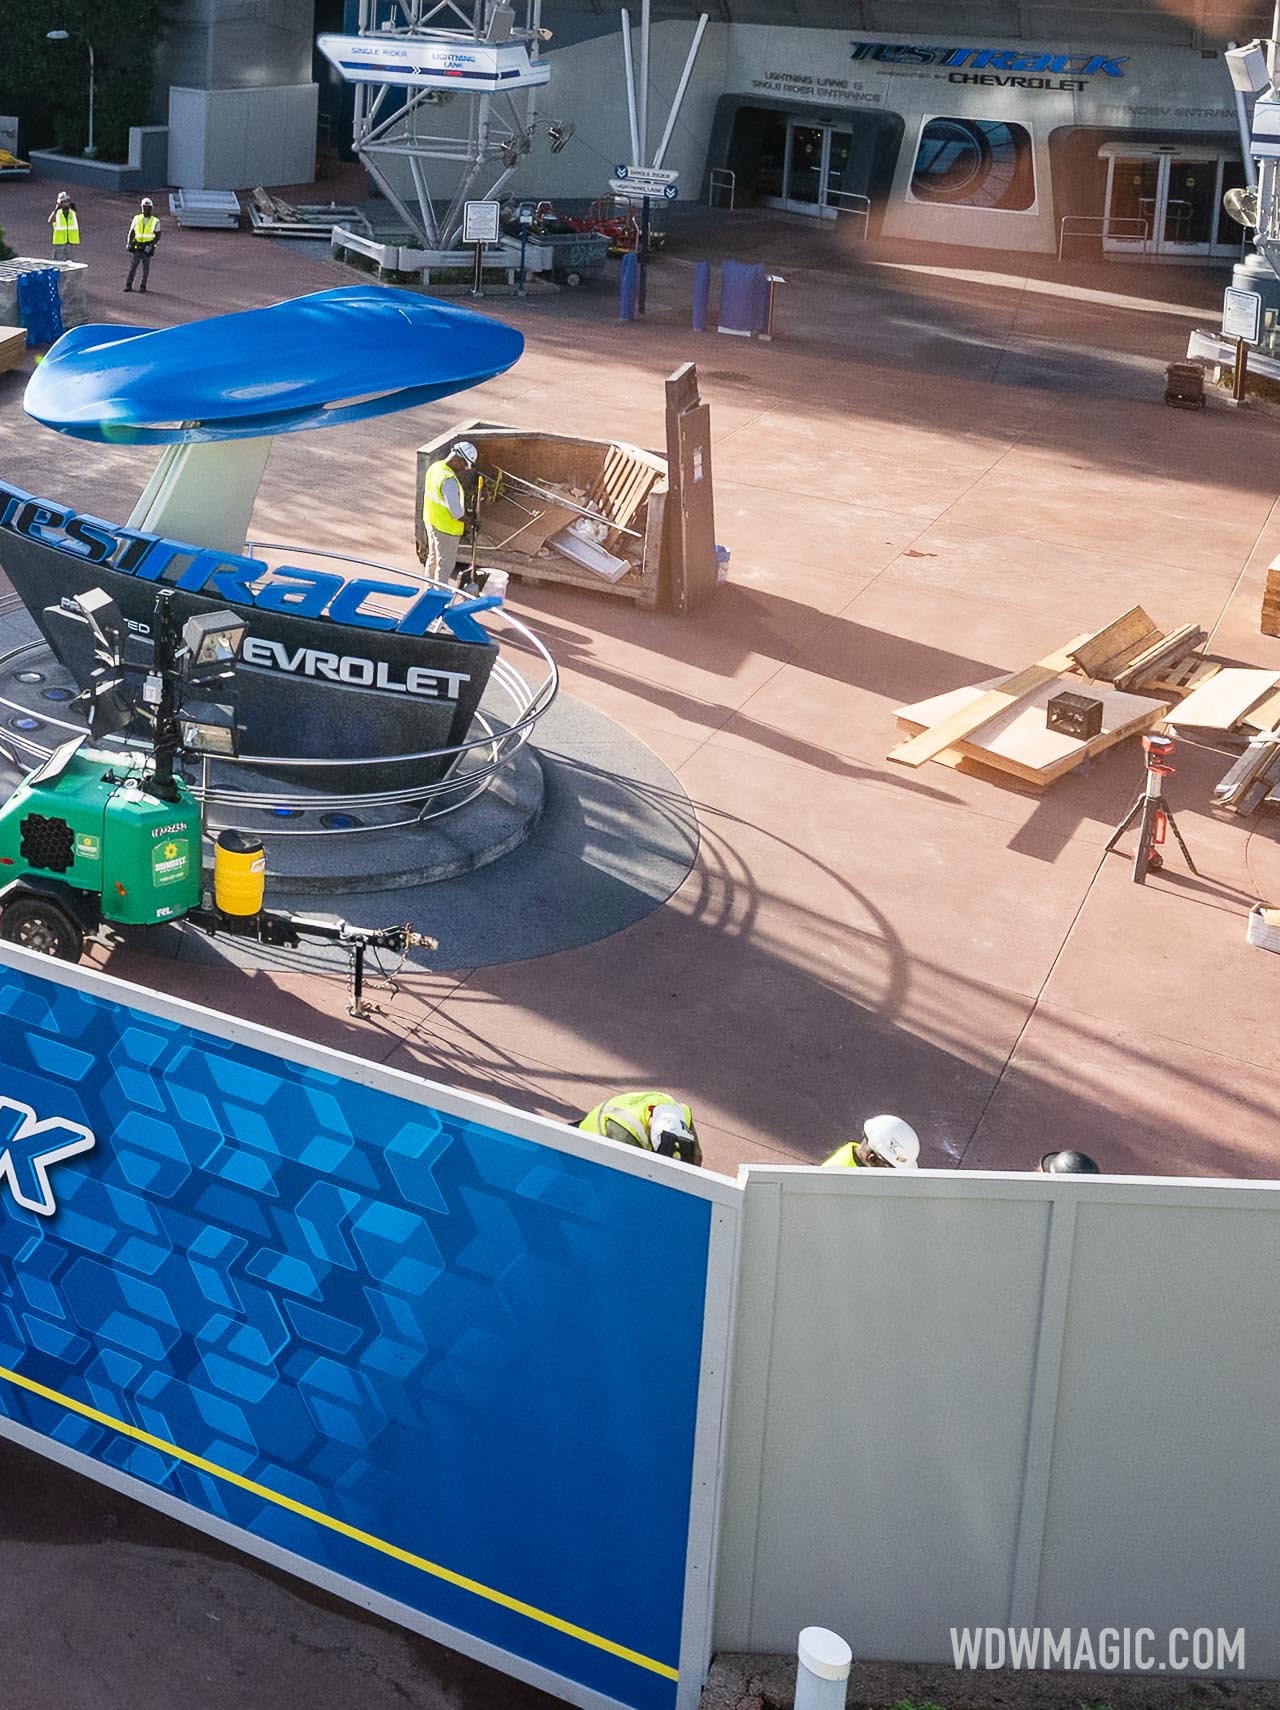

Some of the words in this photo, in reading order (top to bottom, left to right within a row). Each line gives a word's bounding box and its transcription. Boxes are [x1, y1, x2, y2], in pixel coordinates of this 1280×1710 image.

[351, 47, 379, 56] SINGLE
[383, 50, 407, 58] RIDER
[432, 53, 476, 62] LIGHTNING
[764, 71, 813, 85] LIGHTNING
[817, 78, 848, 89] LANE
[948, 72, 1089, 92] CHEVROLET
[752, 79, 781, 91] SINGLE
[783, 84, 814, 95] RIDER
[817, 87, 881, 102] ENTRANCE
[1175, 107, 1253, 119] ENTRAN
[242, 636, 471, 699] EVROLET
